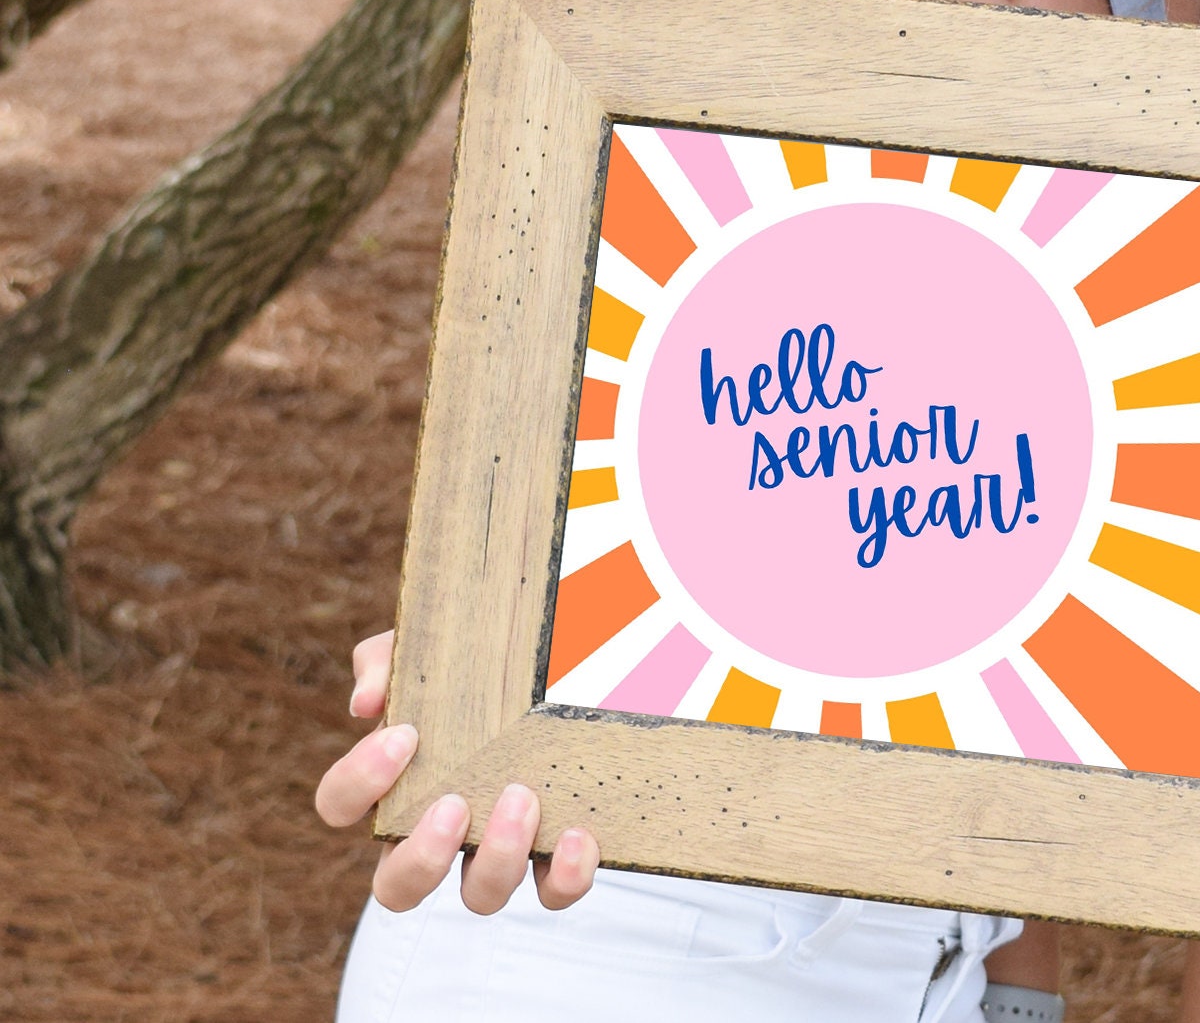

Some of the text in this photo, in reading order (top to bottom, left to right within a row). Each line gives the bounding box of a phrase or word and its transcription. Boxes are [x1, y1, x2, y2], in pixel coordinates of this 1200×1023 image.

[699, 323, 884, 426] hello
[748, 405, 980, 491] senior
[848, 433, 1040, 569] year!
